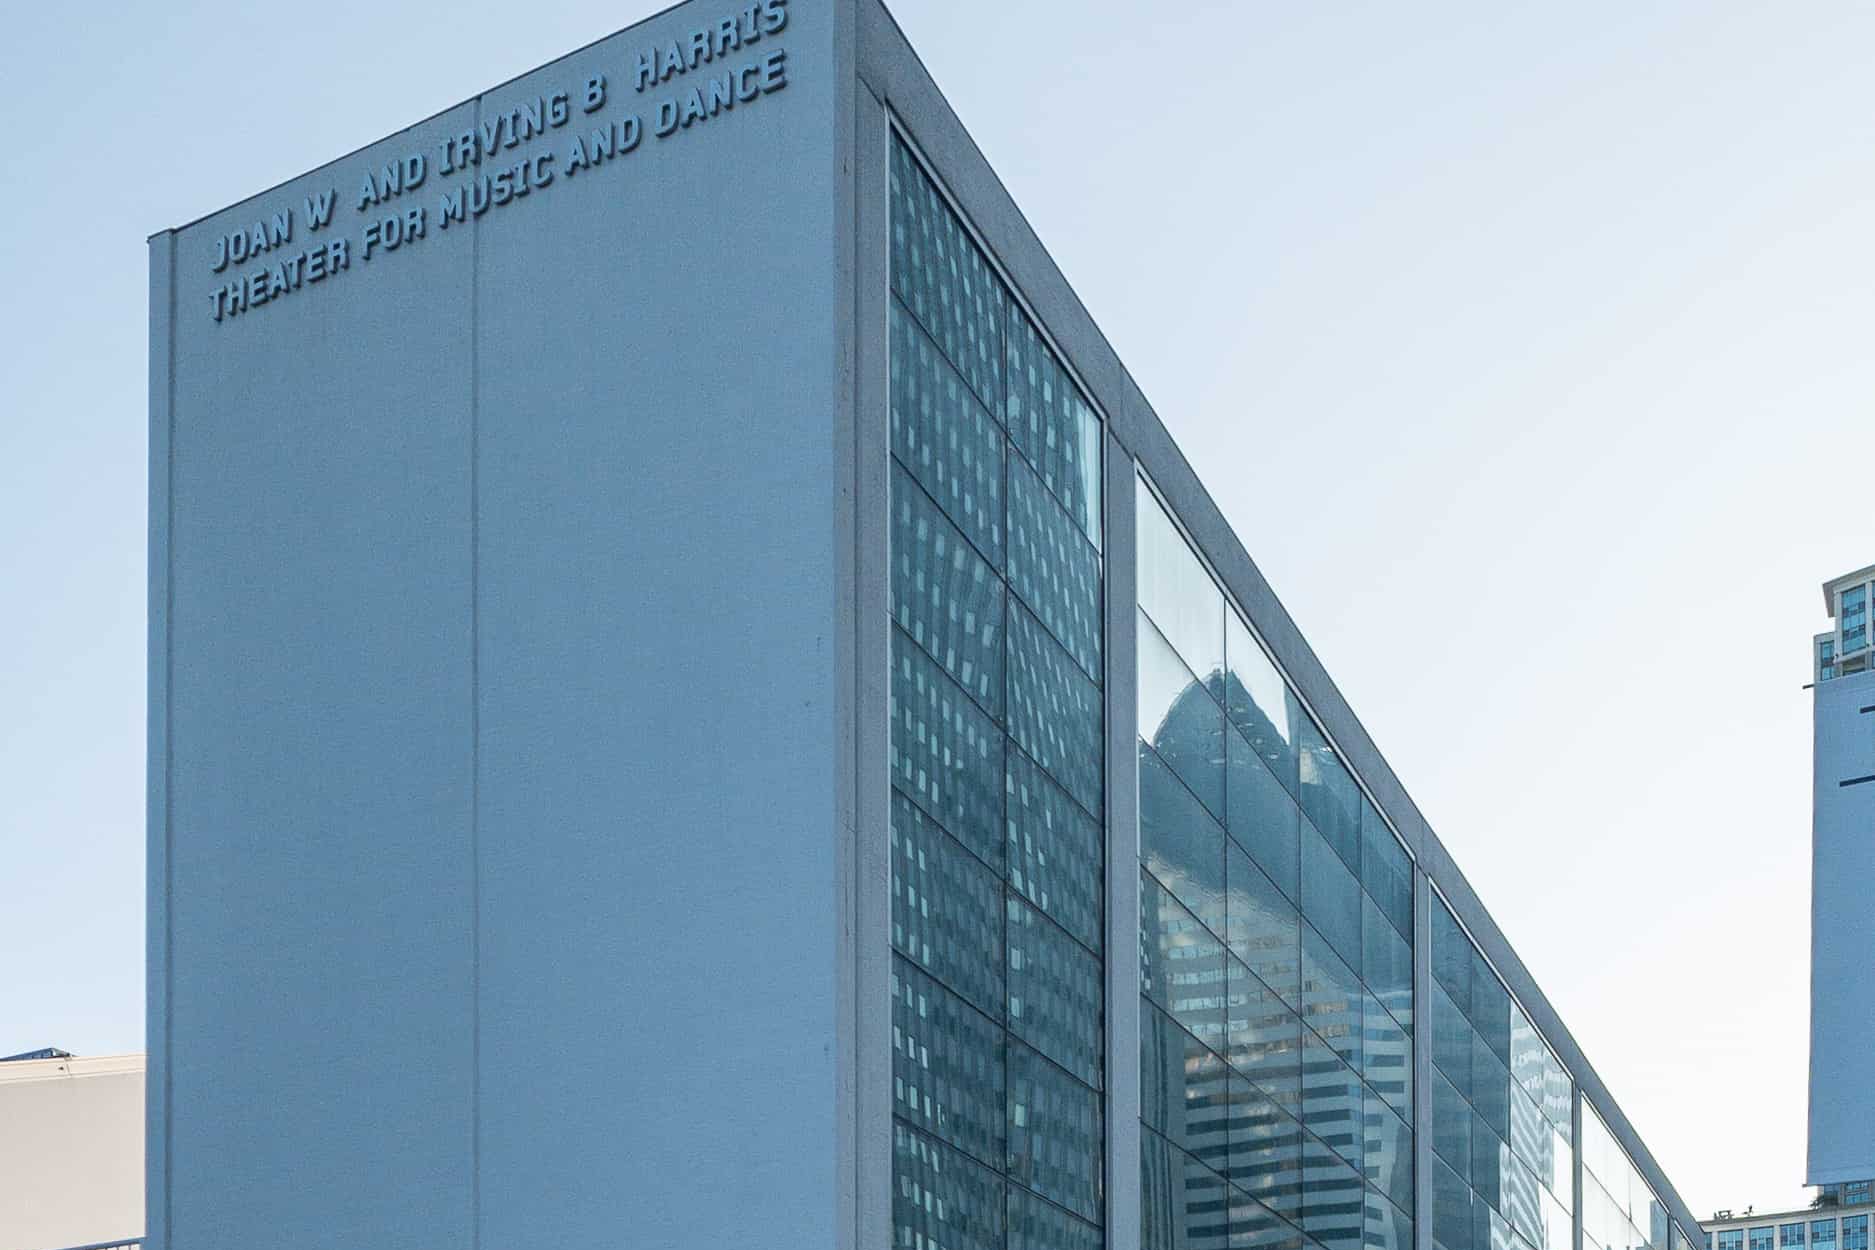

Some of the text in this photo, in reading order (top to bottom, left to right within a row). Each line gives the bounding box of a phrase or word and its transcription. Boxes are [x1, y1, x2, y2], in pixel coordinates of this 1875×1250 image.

[208, 48, 788, 322] THEATER FOR MUSIC AND DANCE
[210, 0, 788, 273] JOAN W AND IRVING B HARRIS
